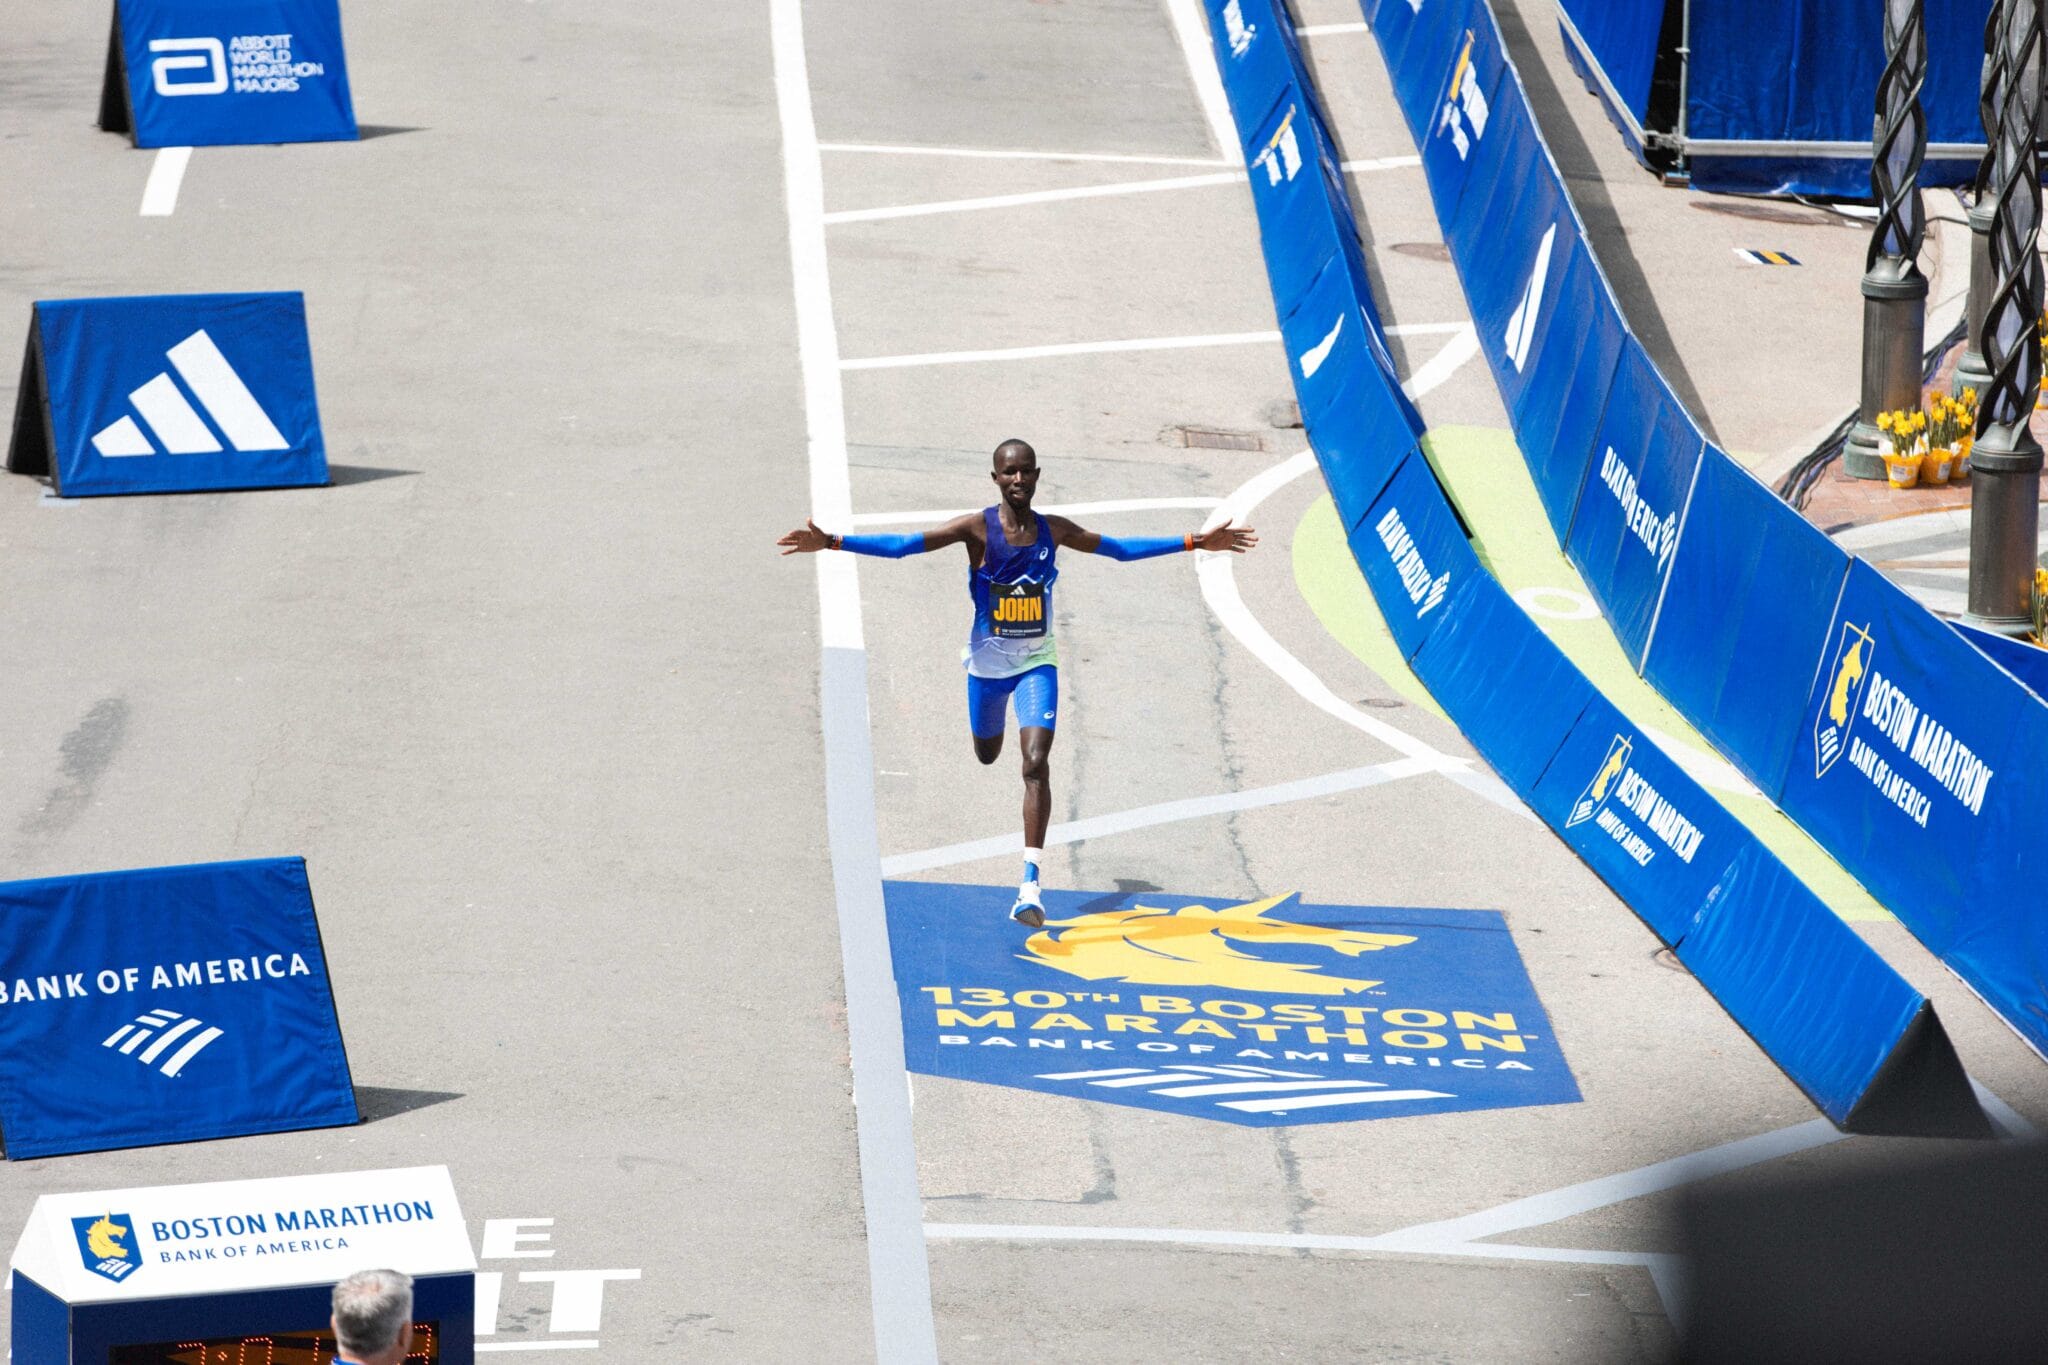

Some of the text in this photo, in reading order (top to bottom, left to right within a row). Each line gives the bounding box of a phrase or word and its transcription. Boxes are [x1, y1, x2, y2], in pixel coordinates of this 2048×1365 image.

[229, 34, 293, 51] ABBOTT
[229, 49, 292, 65] WORLD
[231, 61, 324, 78] MARATHON
[234, 76, 300, 93] MAJORS
[993, 596, 1042, 622] JOHN
[1863, 671, 1992, 816] BOSTON MARATHON
[1849, 736, 1932, 828] BANK OF AMERICA
[1615, 767, 1705, 864] BOSTON MARATHON
[97, 967, 139, 994] OF
[151, 953, 310, 990] AMERICA
[920, 986, 1518, 1031] 130TH BOSTON
[936, 1008, 1528, 1053] MARATHON
[939, 1034, 1534, 1071] BANK OF AMERICA
[152, 1200, 434, 1242] BOSTON MARATHON
[160, 1237, 349, 1263] BANK OF AMERICA
